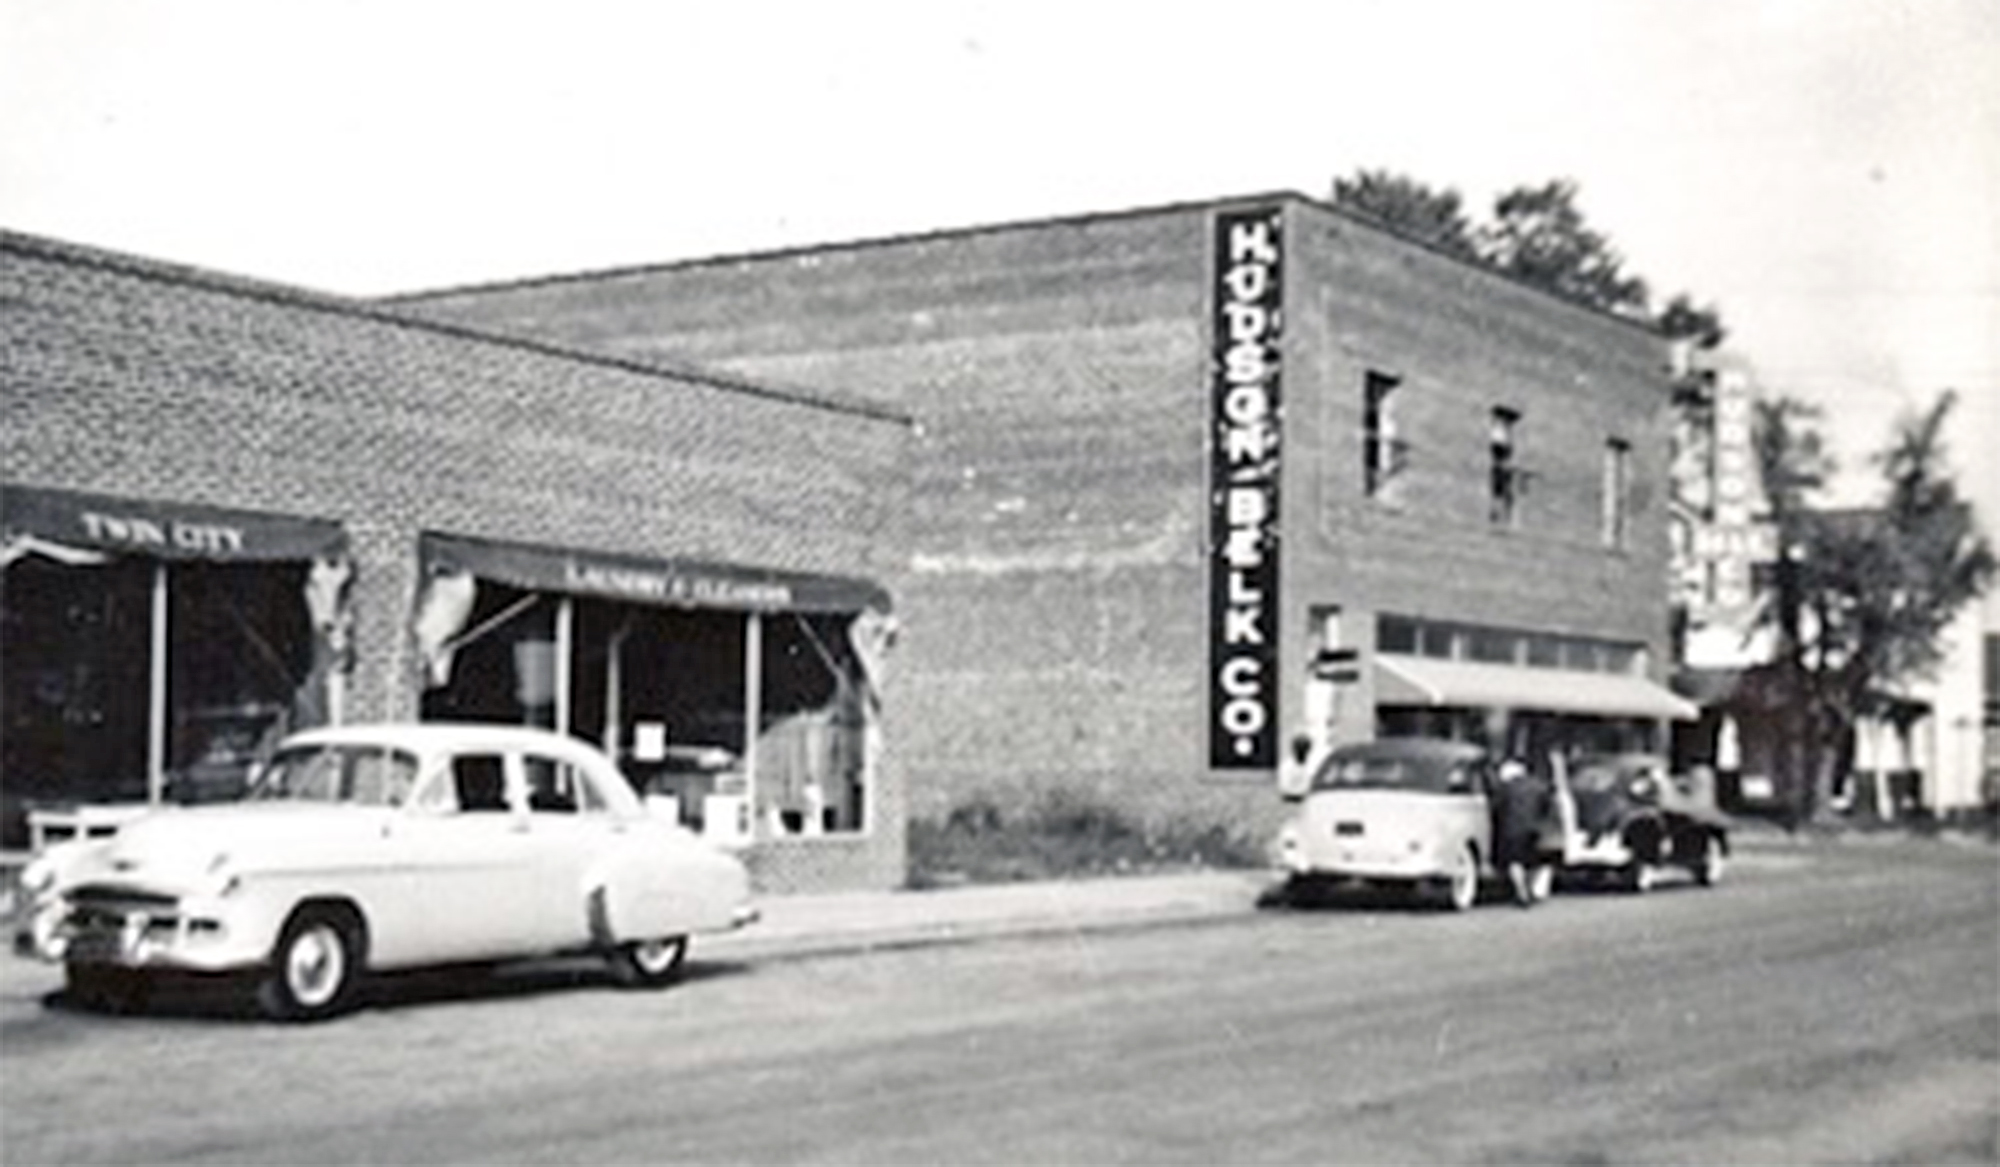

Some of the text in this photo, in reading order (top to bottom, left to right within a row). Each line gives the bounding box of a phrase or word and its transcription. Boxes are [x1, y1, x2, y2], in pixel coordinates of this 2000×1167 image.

[81, 511, 245, 552] TWIN CITY
[1220, 657, 1267, 758] CO.
